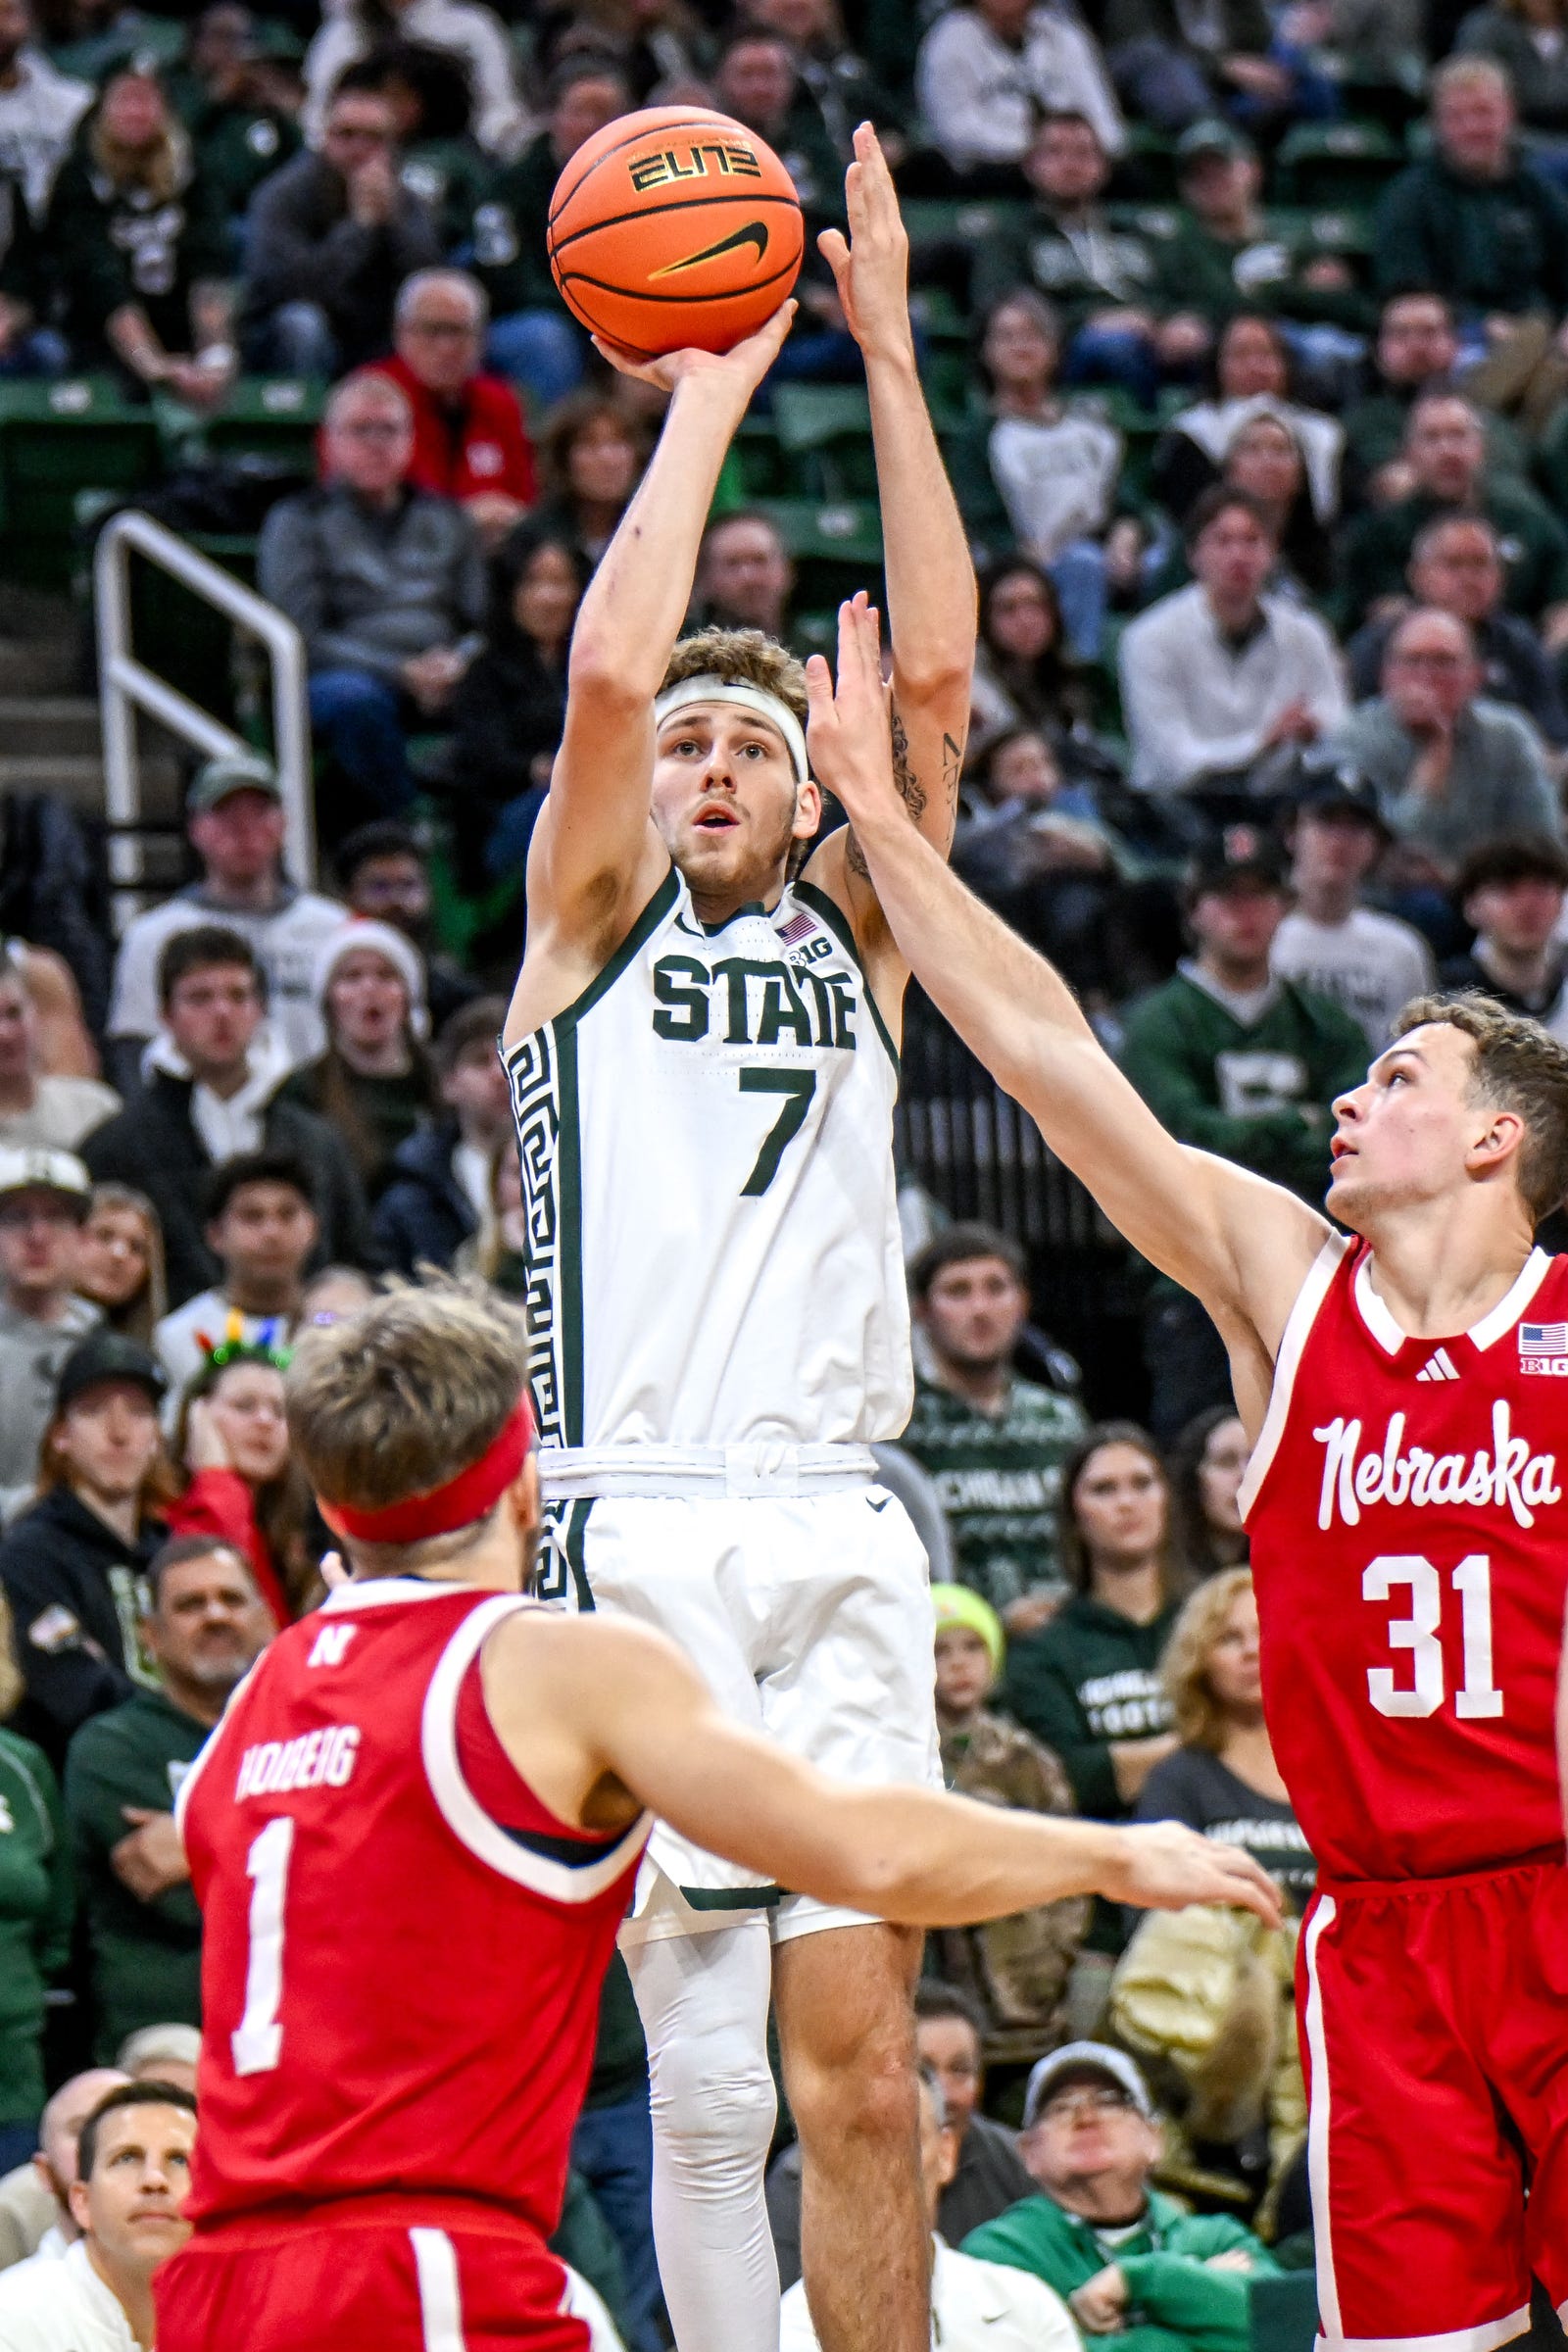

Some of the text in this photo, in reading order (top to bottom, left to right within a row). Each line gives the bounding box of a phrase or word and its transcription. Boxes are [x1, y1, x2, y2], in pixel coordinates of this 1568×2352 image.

[628, 145, 761, 192] ELITE
[653, 955, 857, 1051] STATE
[739, 1066, 816, 1197] 7
[1312, 1398, 1562, 1531] Nebraska
[307, 1624, 357, 1668] N
[1362, 1554, 1503, 1718] 31
[230, 1815, 295, 2077] 1
